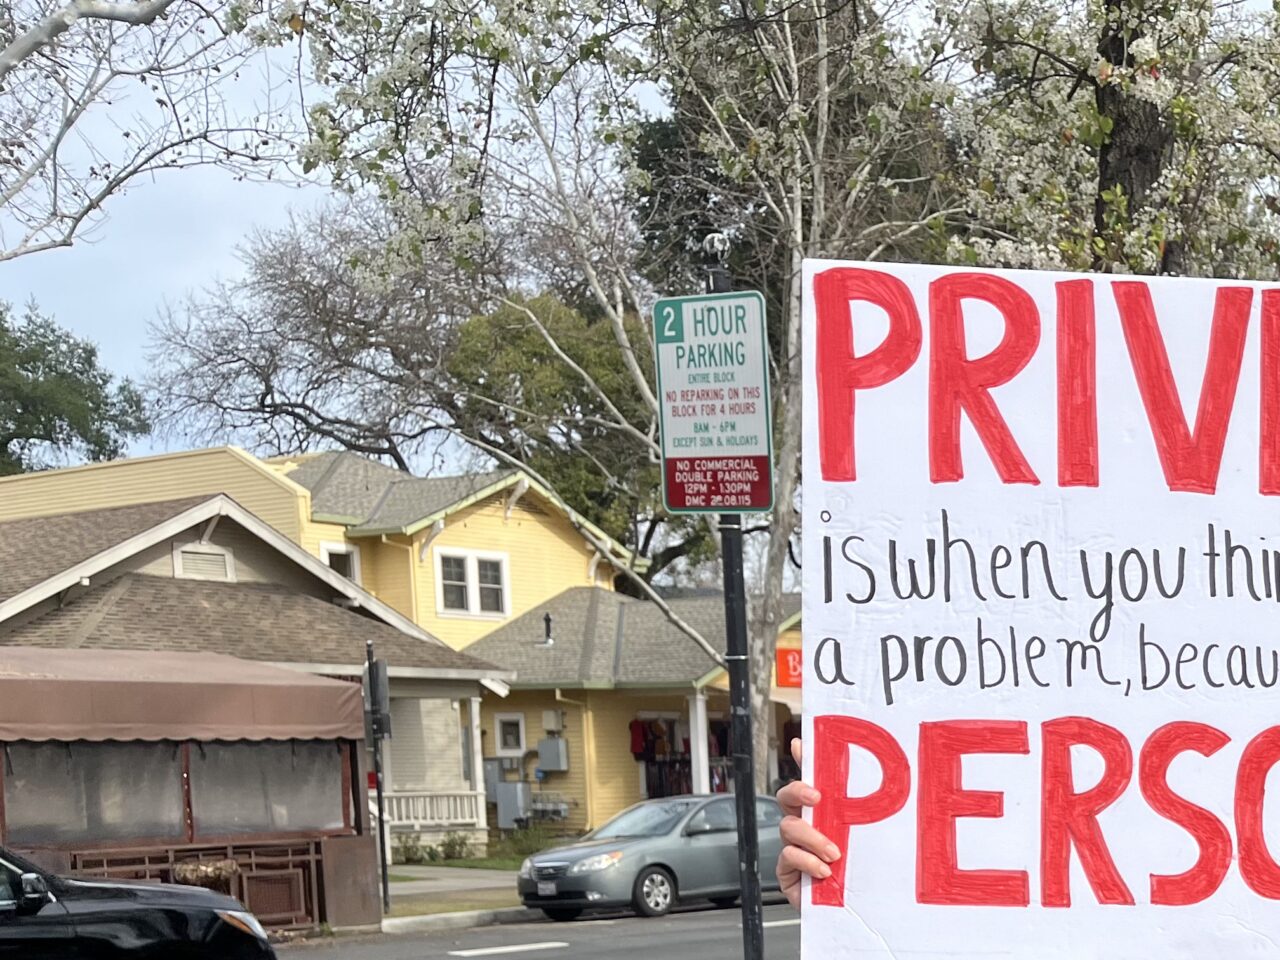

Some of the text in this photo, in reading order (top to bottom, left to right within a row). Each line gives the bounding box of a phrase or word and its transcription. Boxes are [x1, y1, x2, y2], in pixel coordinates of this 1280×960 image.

[662, 304, 747, 337] 2 HOUR
[675, 341, 746, 369] PARKING
[688, 372, 735, 384] ENTIRE BLOCK
[666, 386, 760, 403] NO REPARKING ON THIS
[672, 403, 756, 417] BLOCK FOR 4 HOURS
[693, 422, 709, 433] 8AM
[720, 421, 736, 432] 6PM
[673, 437, 697, 448] EXCEPT
[700, 436, 714, 447] SUN
[726, 435, 758, 446] HOLIDAYS
[676, 459, 757, 471] NO COMMERCIAL
[675, 471, 759, 483] DOUBLE PARKING
[684, 483, 707, 494] 12PM
[685, 495, 706, 506] DMC
[821, 509, 876, 604] is
[889, 509, 1068, 603] when
[1080, 547, 1186, 642] you
[814, 637, 854, 686] a
